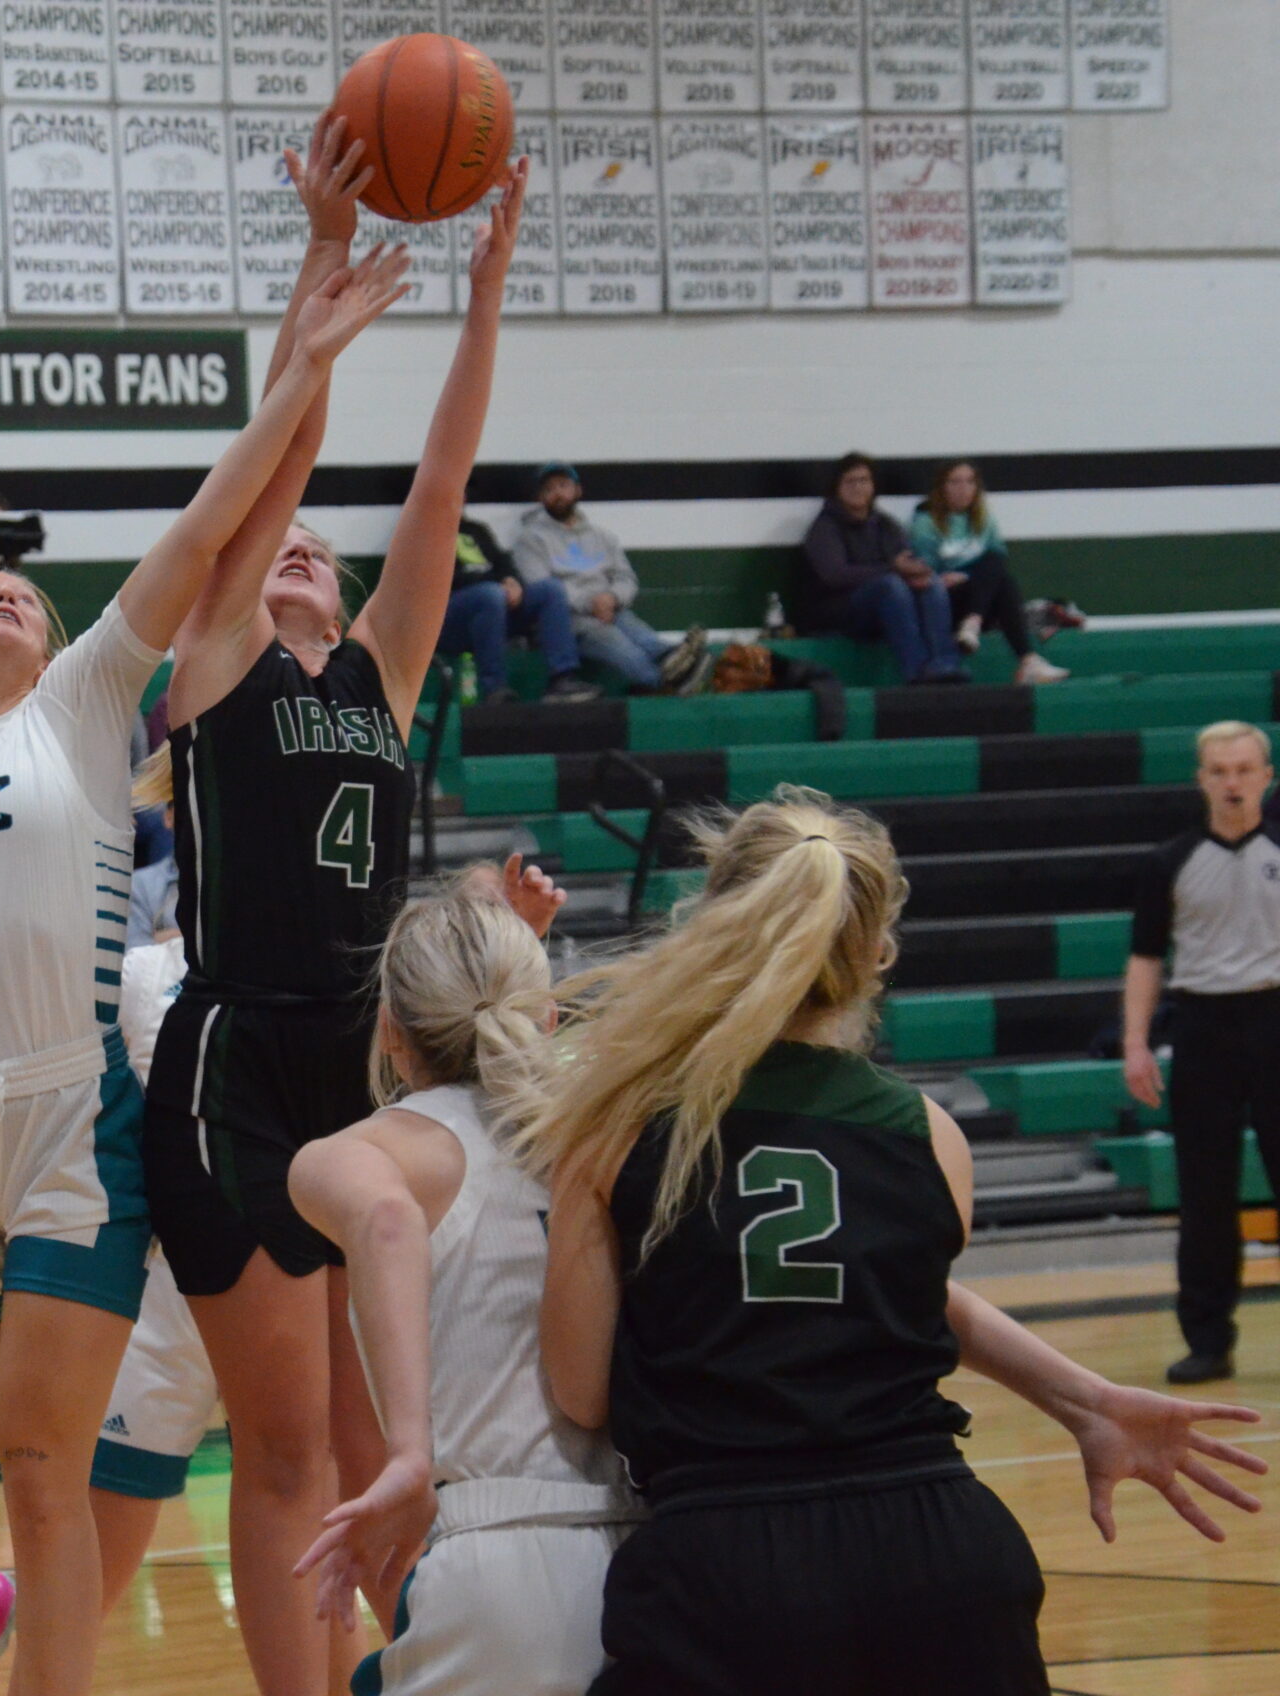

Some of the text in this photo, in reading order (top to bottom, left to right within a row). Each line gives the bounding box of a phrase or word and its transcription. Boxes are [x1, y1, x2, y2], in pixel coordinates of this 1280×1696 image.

[4, 6, 104, 36] CHAMPIONS
[120, 9, 218, 39] CHAMPIONS
[231, 11, 329, 42] CHAMPIONS
[558, 21, 648, 49] CHAMPIONS
[667, 21, 754, 49] CHAMPIONS
[35, 45, 107, 64] BASKETBALL
[120, 43, 218, 66] SOFTBALL
[234, 48, 328, 67] BOYS GOLF
[15, 69, 98, 91] 2014-15
[143, 72, 196, 94] 2015
[257, 74, 308, 95] 2016
[10, 126, 108, 154] LIGHTNING
[125, 126, 220, 154] LIGHTNING
[563, 139, 652, 168] IRISH
[772, 137, 859, 165] IRISH
[11, 188, 111, 216] CONFERENCE
[124, 188, 225, 216] CONFERENCE
[13, 219, 112, 247] CHAMPIONS
[128, 219, 225, 247] CHAMPIONS
[568, 224, 656, 249] CHAMPIONS
[14, 259, 115, 276] WRESTLING
[131, 260, 229, 277] WRESTLING
[24, 282, 107, 302] 2014-15
[140, 282, 221, 302] 2015-16
[116, 353, 228, 405] FANS
[273, 697, 405, 771] IRISH
[317, 783, 375, 889] 4
[738, 1145, 844, 1304] 2
